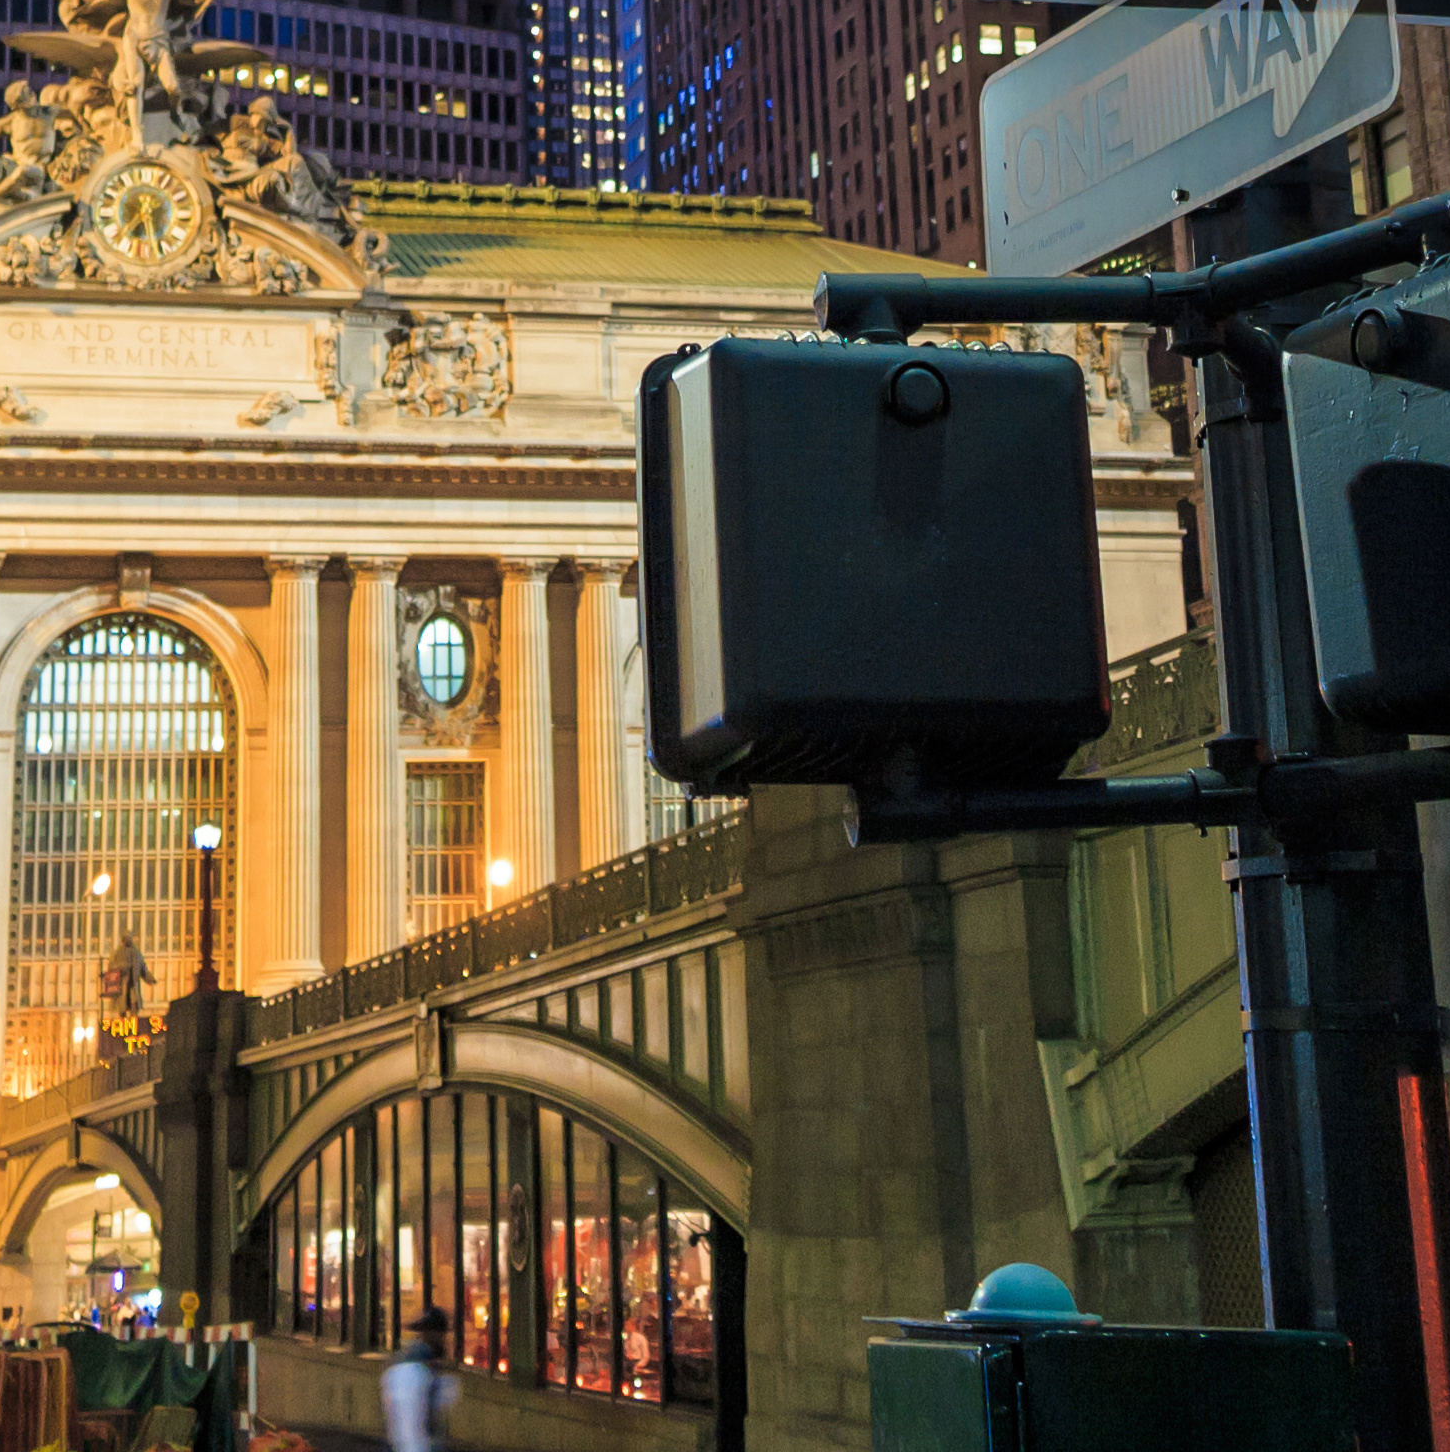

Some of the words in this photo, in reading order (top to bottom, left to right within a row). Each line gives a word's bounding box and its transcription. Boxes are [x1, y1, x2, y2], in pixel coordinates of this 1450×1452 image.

[1015, 72, 1135, 210] ONE
[7, 321, 114, 343] GRAND
[137, 325, 275, 348] CENTRAL
[67, 346, 218, 368] TERMINAL
